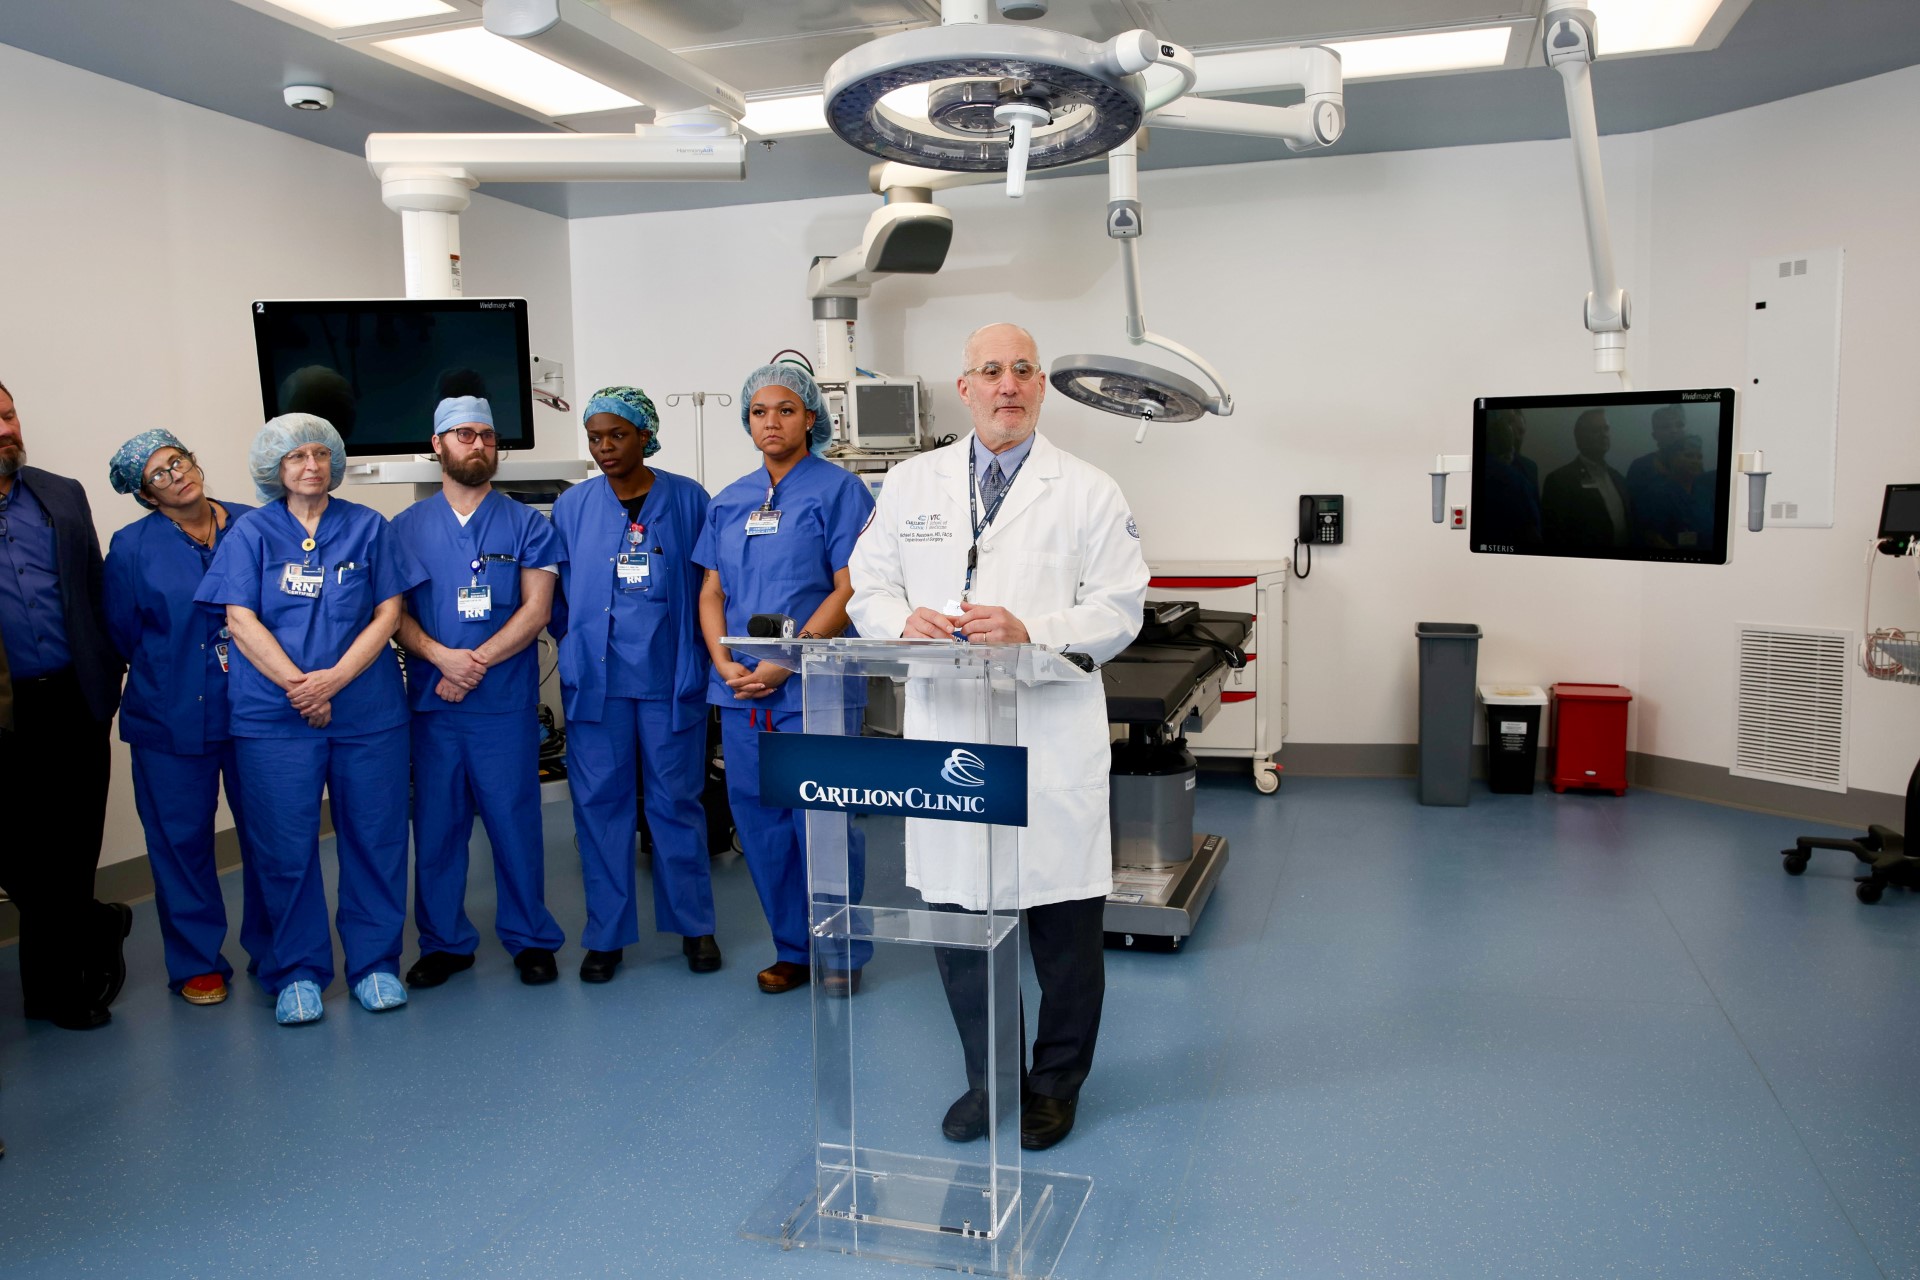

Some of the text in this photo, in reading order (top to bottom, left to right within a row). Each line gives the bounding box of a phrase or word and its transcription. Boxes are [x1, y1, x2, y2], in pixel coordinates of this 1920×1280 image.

[1327, 111, 1333, 132] 1
[256, 302, 265, 313] 2
[508, 301, 516, 309] 4K
[1713, 391, 1721, 399] 4K
[1488, 544, 1514, 553] STERIS
[626, 576, 643, 584] RN
[291, 582, 315, 593] RN
[465, 609, 485, 619] RN
[799, 780, 985, 814] CARILION CLINIC
